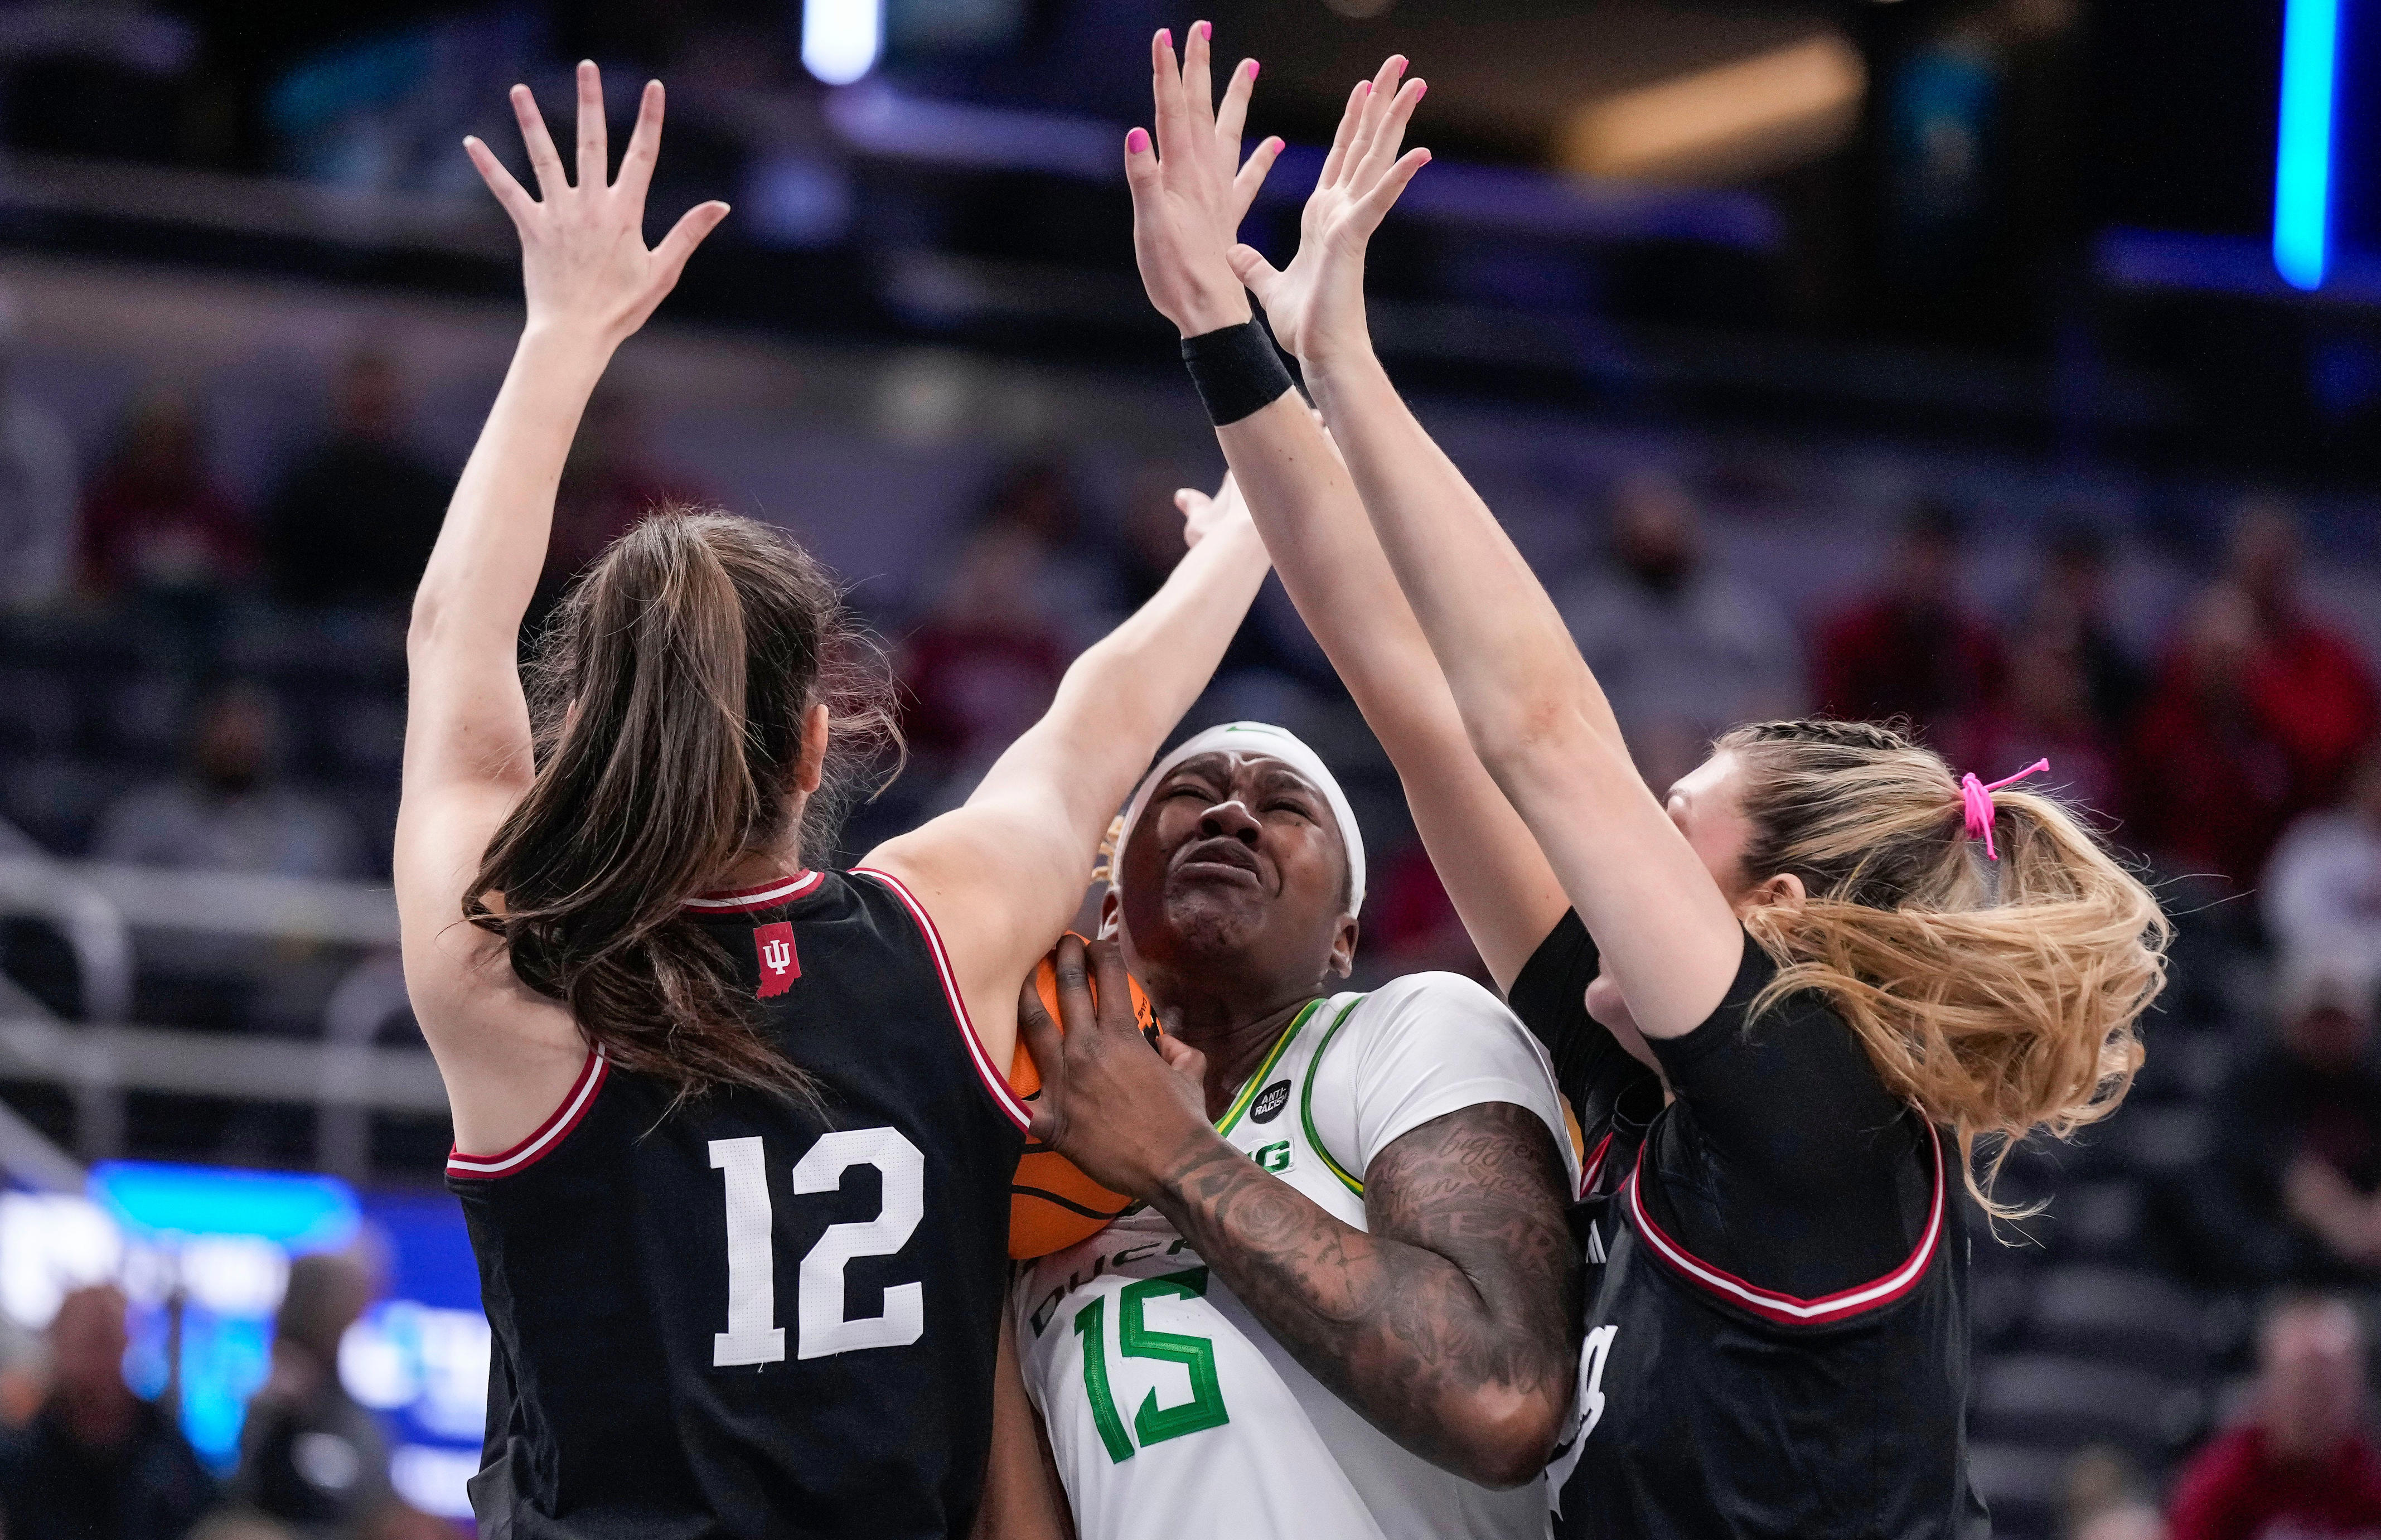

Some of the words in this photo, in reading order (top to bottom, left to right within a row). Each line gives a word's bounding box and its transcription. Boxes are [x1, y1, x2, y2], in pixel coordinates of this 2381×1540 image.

[1255, 1091, 1289, 1116] RACISM
[1261, 1087, 1286, 1105] ANTI-
[708, 1126, 925, 1367] 12
[1074, 1265, 1230, 1465] 15
